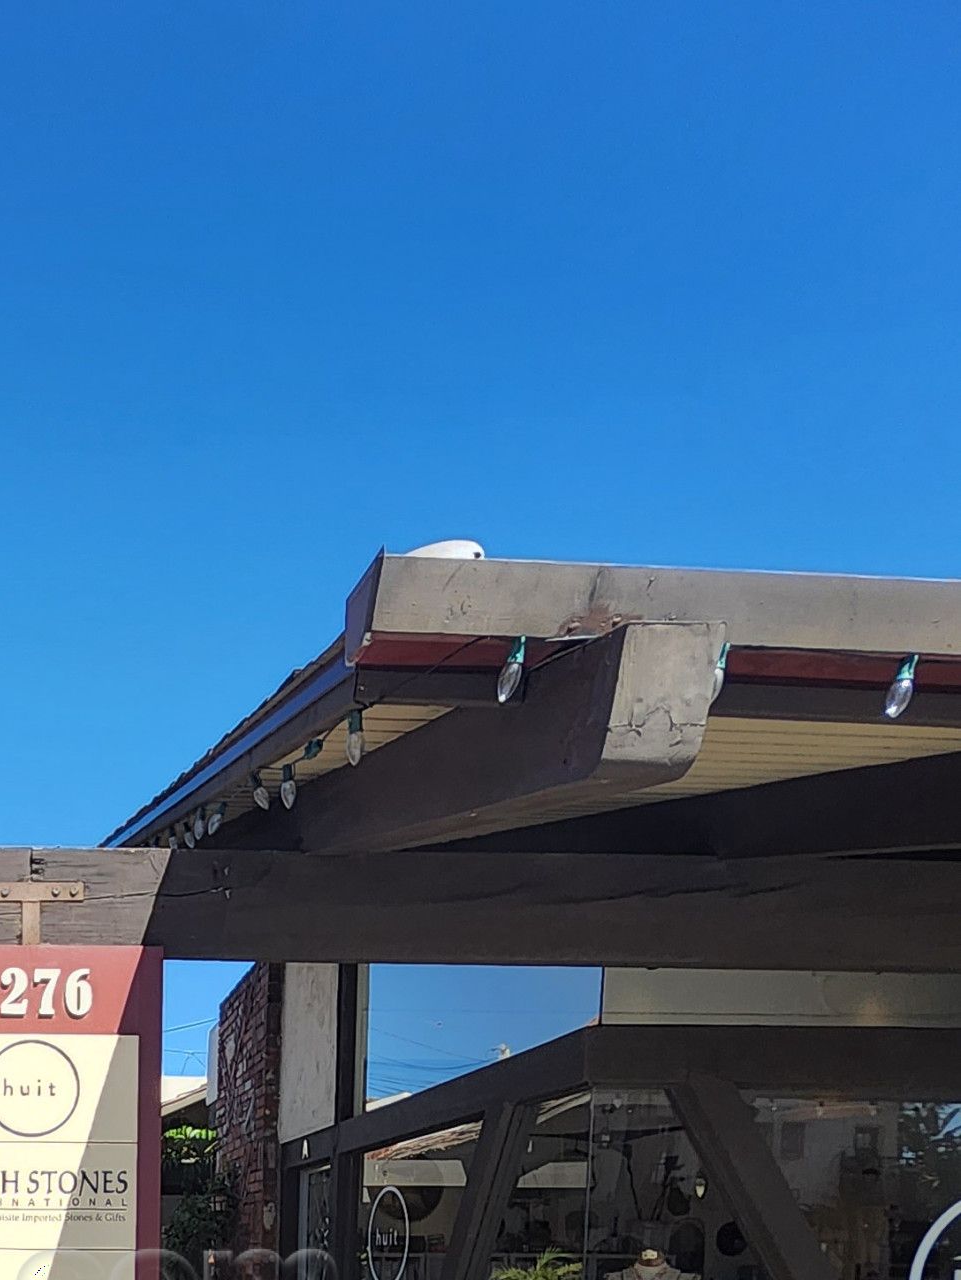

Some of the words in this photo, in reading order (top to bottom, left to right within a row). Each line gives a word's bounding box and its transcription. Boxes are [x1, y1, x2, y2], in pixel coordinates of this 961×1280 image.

[3, 1078, 56, 1097] huit
[27, 1169, 128, 1197] STONES
[22, 1213, 62, 1225] Imported
[65, 1213, 93, 1222] Stones
[95, 1213, 103, 1222] &
[105, 1212, 126, 1222] Gifts
[375, 1227, 398, 1247] huit
